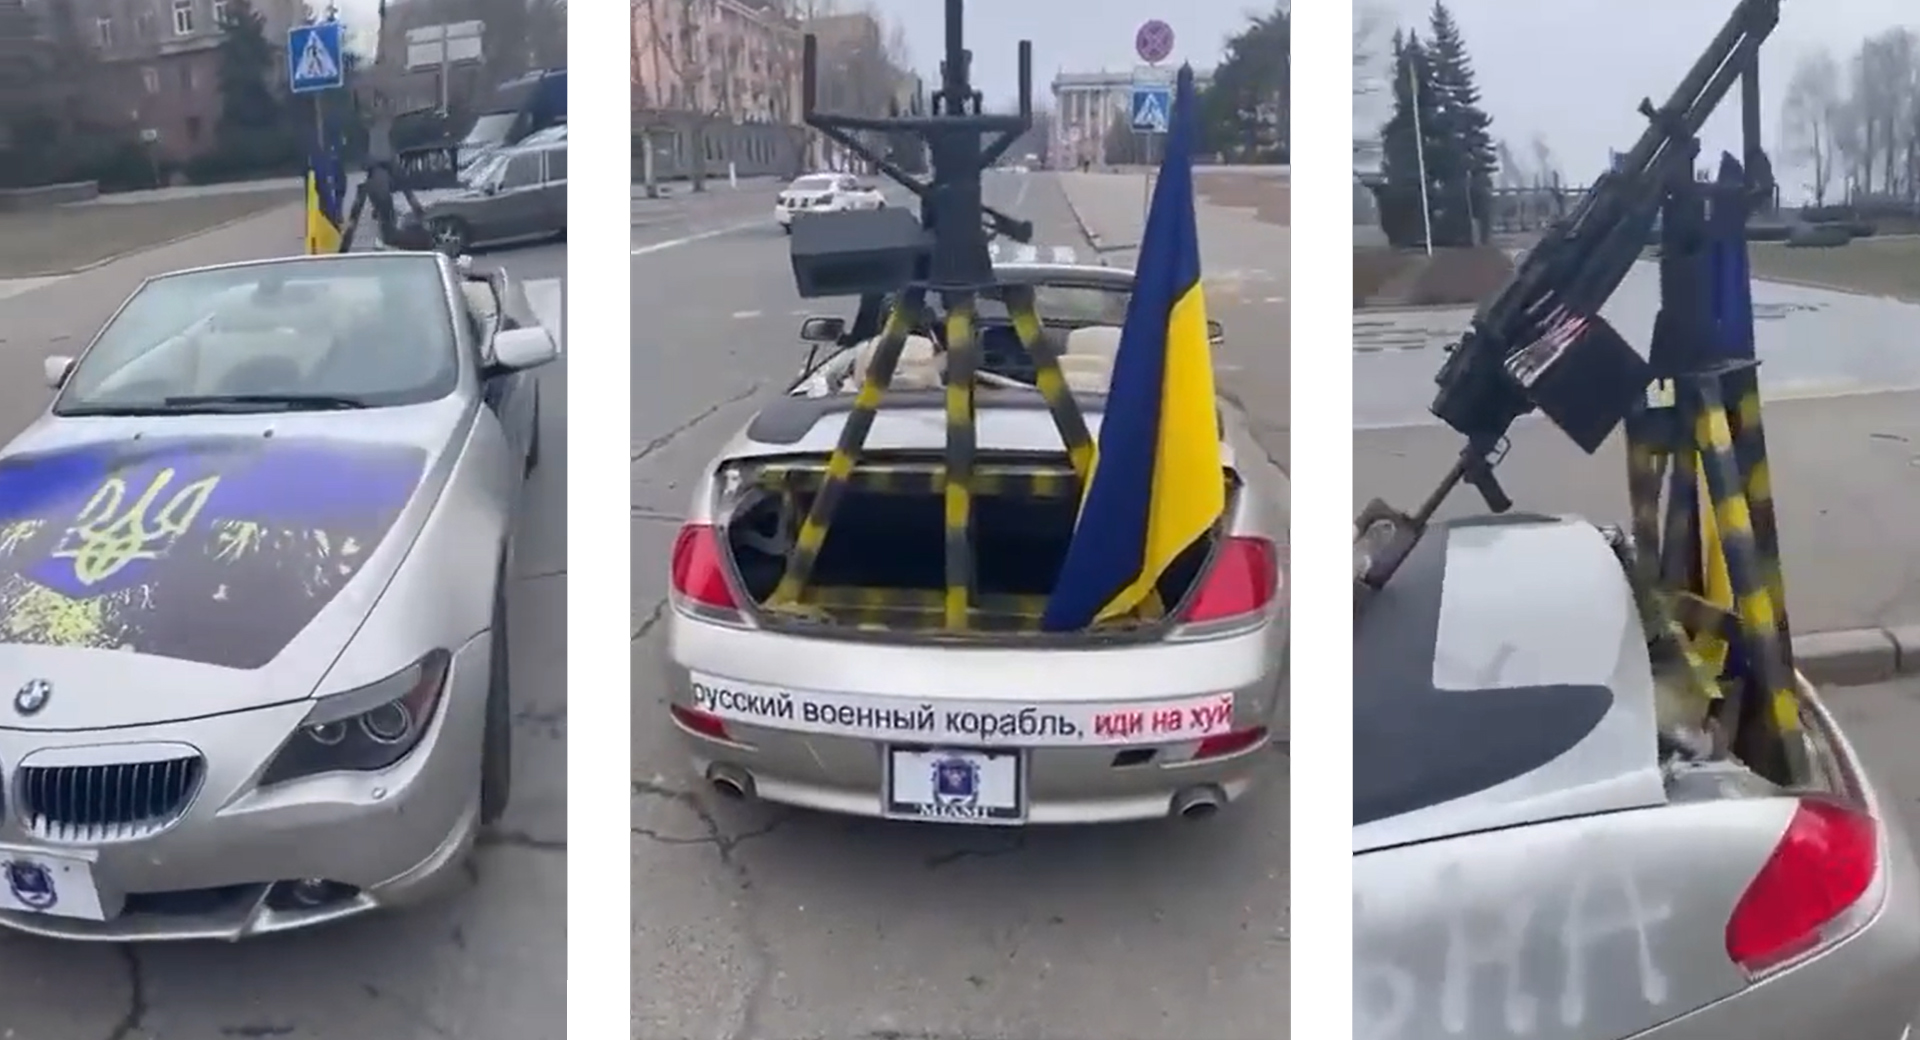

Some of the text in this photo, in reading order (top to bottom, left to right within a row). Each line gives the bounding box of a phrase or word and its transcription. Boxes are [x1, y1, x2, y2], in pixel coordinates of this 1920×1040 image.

[692, 682, 1232, 741] русский военный корабль, иди на хуй
